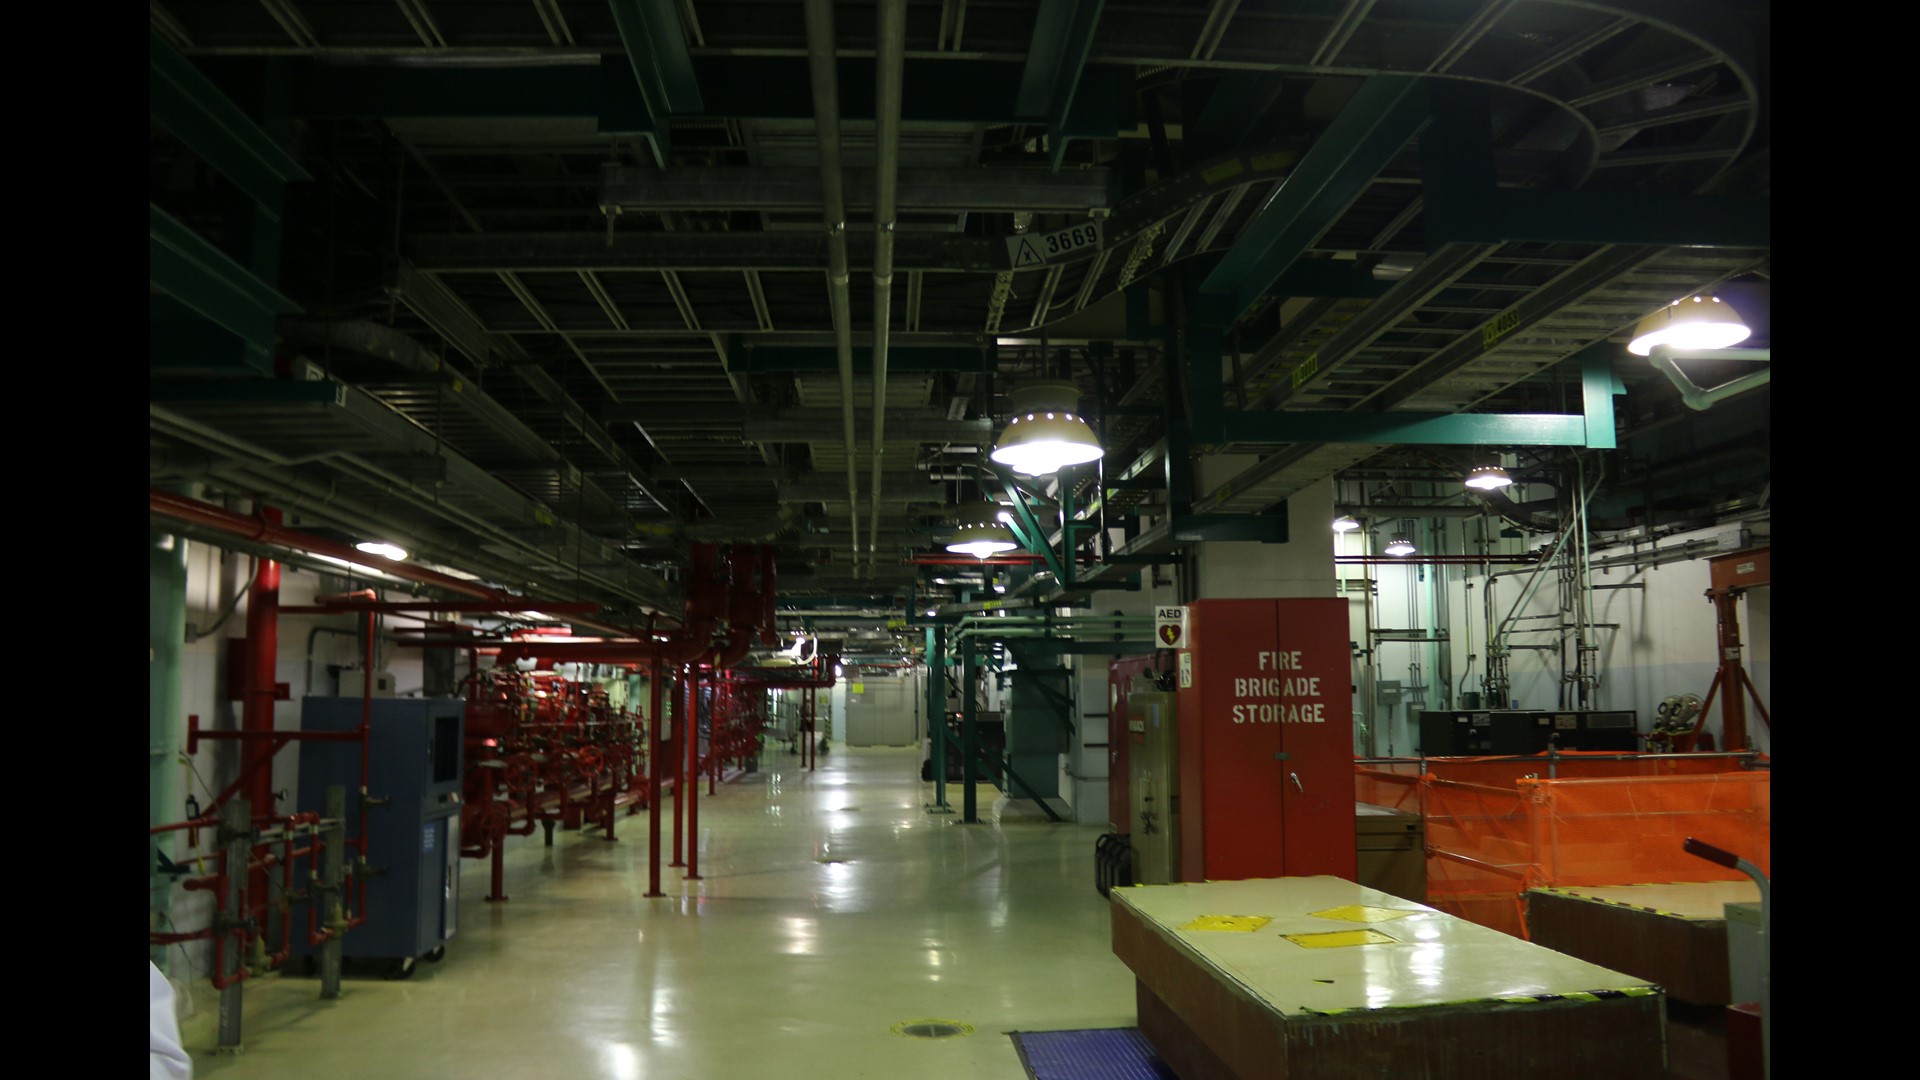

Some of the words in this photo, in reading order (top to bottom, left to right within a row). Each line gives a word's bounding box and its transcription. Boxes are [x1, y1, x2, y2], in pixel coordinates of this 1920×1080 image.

[1046, 225, 1097, 254] 3669
[1158, 609, 1182, 618] AED
[1258, 651, 1302, 670] FIRE
[1235, 677, 1321, 697] BRIGADE
[1232, 703, 1325, 723] STORAGE
